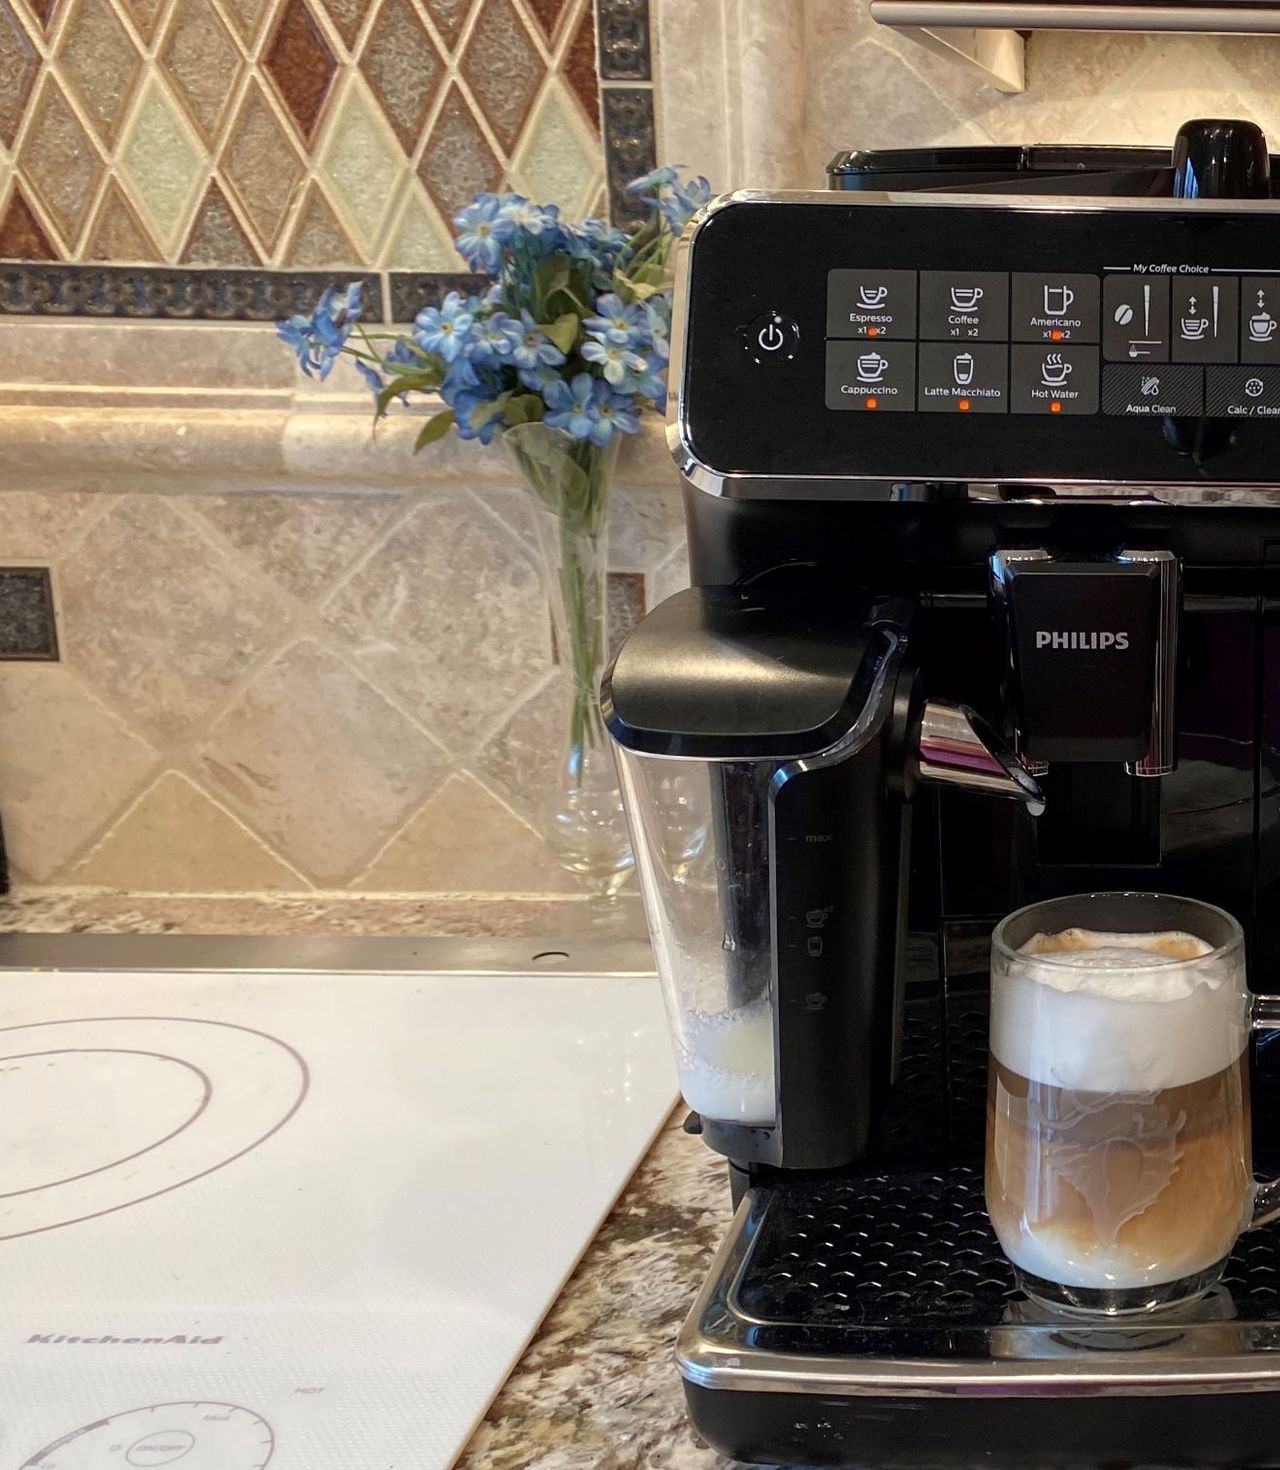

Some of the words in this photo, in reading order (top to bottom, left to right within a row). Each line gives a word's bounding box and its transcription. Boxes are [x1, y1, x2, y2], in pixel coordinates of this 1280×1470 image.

[1133, 264, 1147, 275] My
[1149, 264, 1177, 274] Coffee
[1179, 264, 1209, 274] Choice
[849, 313, 893, 324] Espresso
[948, 315, 979, 325] Coffee
[1030, 317, 1082, 327] Americano
[875, 326, 887, 335] x2
[950, 328, 960, 336] x1
[967, 328, 979, 337] x2
[840, 385, 898, 396] Cappuccino
[924, 387, 950, 397] Latte
[951, 387, 1001, 397] Macchiato
[1031, 389, 1048, 398] Hot
[1050, 389, 1079, 399] Water
[1126, 404, 1150, 416] Aqua
[1151, 404, 1176, 414] Clean
[1227, 405, 1248, 415] Calc
[1036, 631, 1129, 650] PHILIPS
[26, 1334, 225, 1344] KitchenAid
